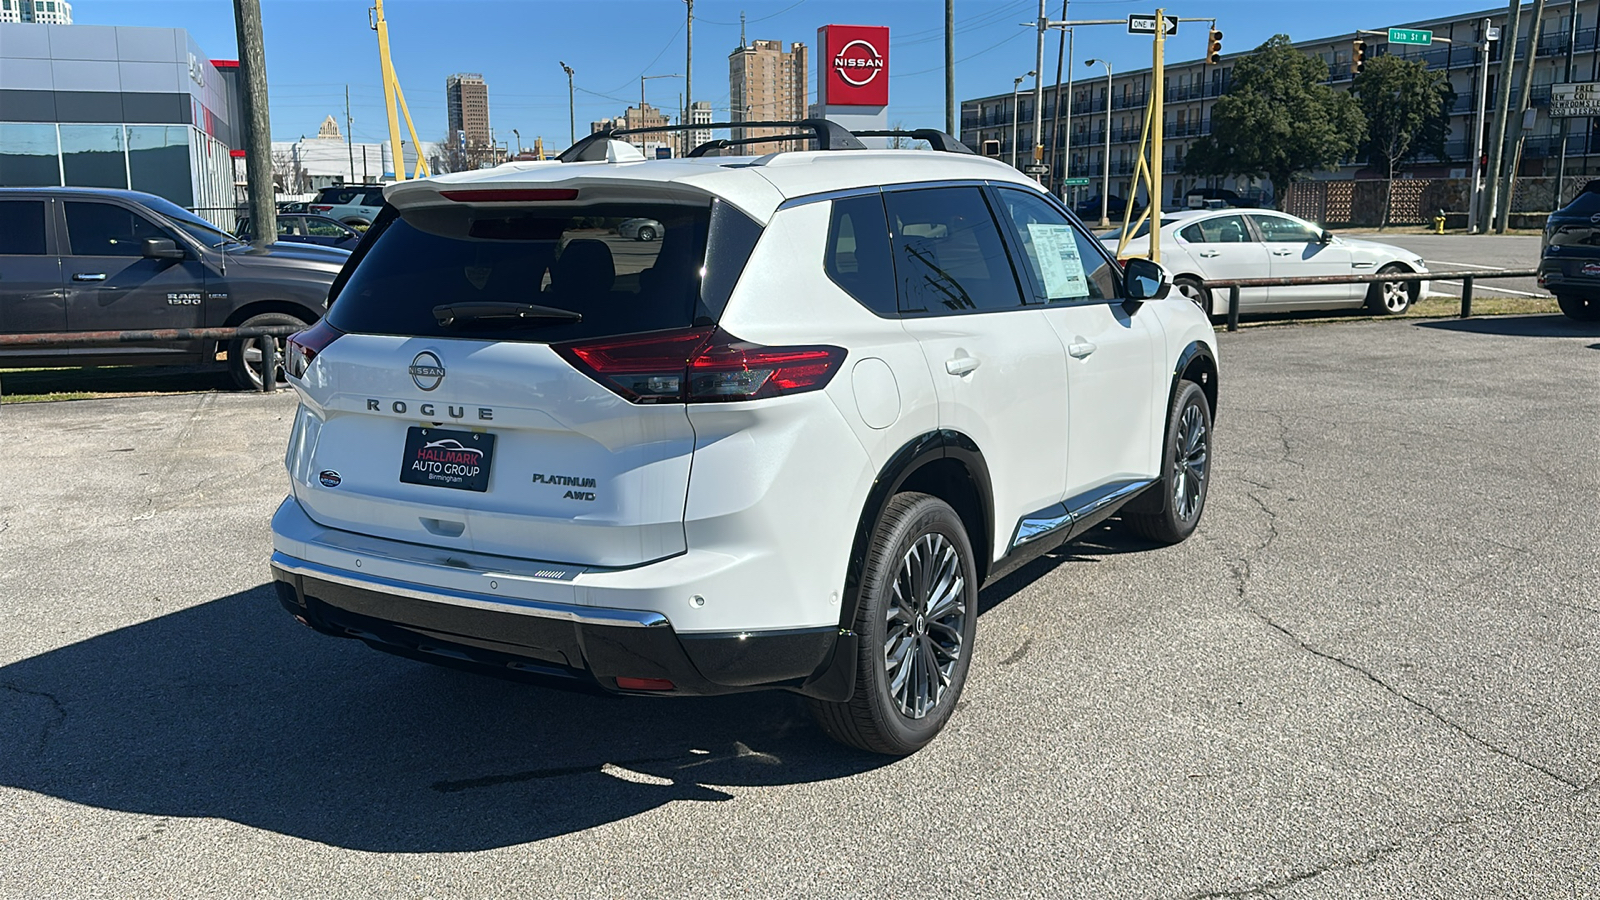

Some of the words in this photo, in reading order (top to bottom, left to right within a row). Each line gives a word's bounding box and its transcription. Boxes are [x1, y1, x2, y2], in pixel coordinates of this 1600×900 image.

[1133, 20, 1147, 28] ONE
[1393, 32, 1407, 40] 13th
[1411, 33, 1418, 41] St
[834, 58, 883, 67] NISSAN
[409, 366, 444, 376] NISSAN
[366, 398, 493, 420] ROGUE
[417, 448, 479, 466] HALLMARK
[411, 460, 442, 473] AUTO
[444, 464, 480, 477] GROUP
[428, 473, 462, 483] Birmingham
[532, 473, 597, 488] PLATINUM
[563, 490, 596, 501] AWD
